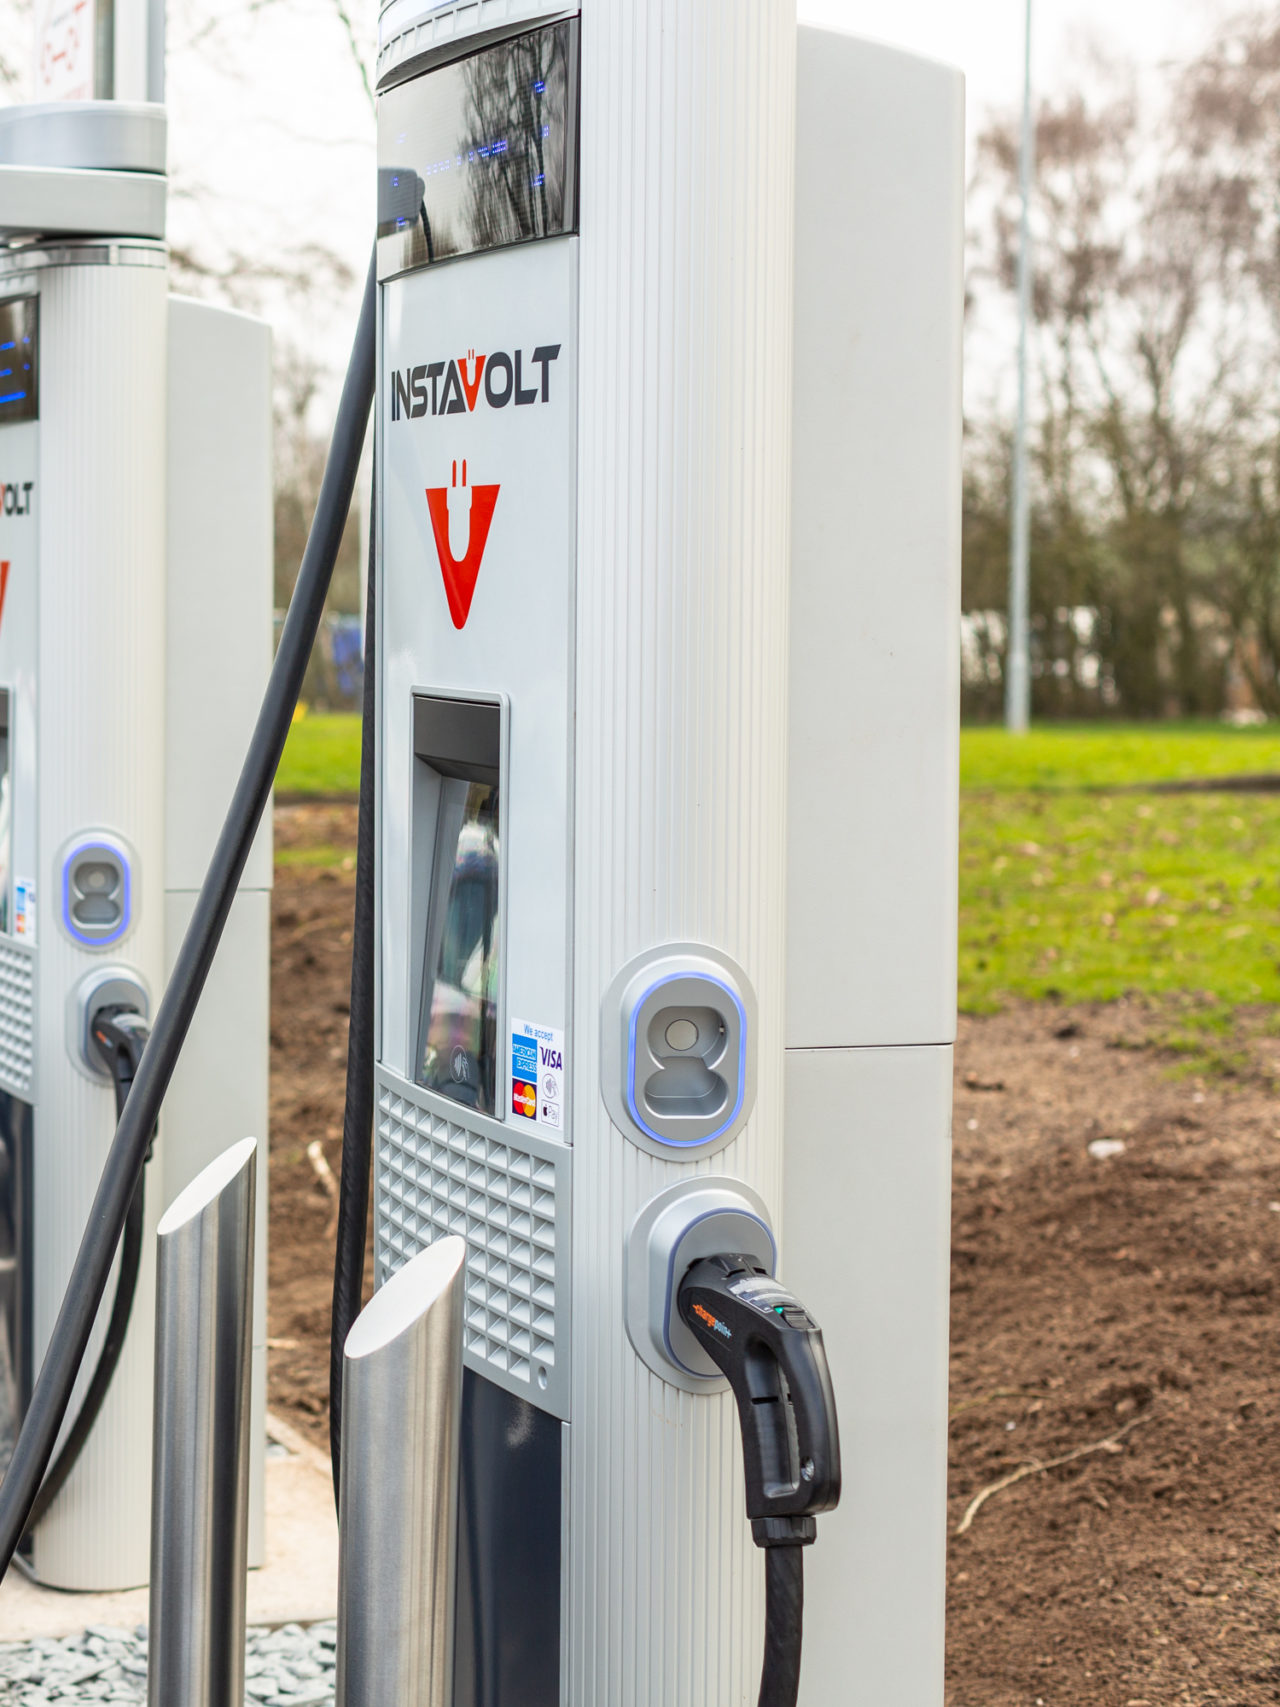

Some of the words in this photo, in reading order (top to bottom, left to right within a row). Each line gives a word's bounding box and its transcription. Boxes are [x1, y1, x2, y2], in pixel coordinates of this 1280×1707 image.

[391, 344, 562, 422] INSTAVOLT
[523, 1023, 534, 1036] We
[534, 1028, 554, 1042] accept
[539, 1045, 563, 1071] VISA
